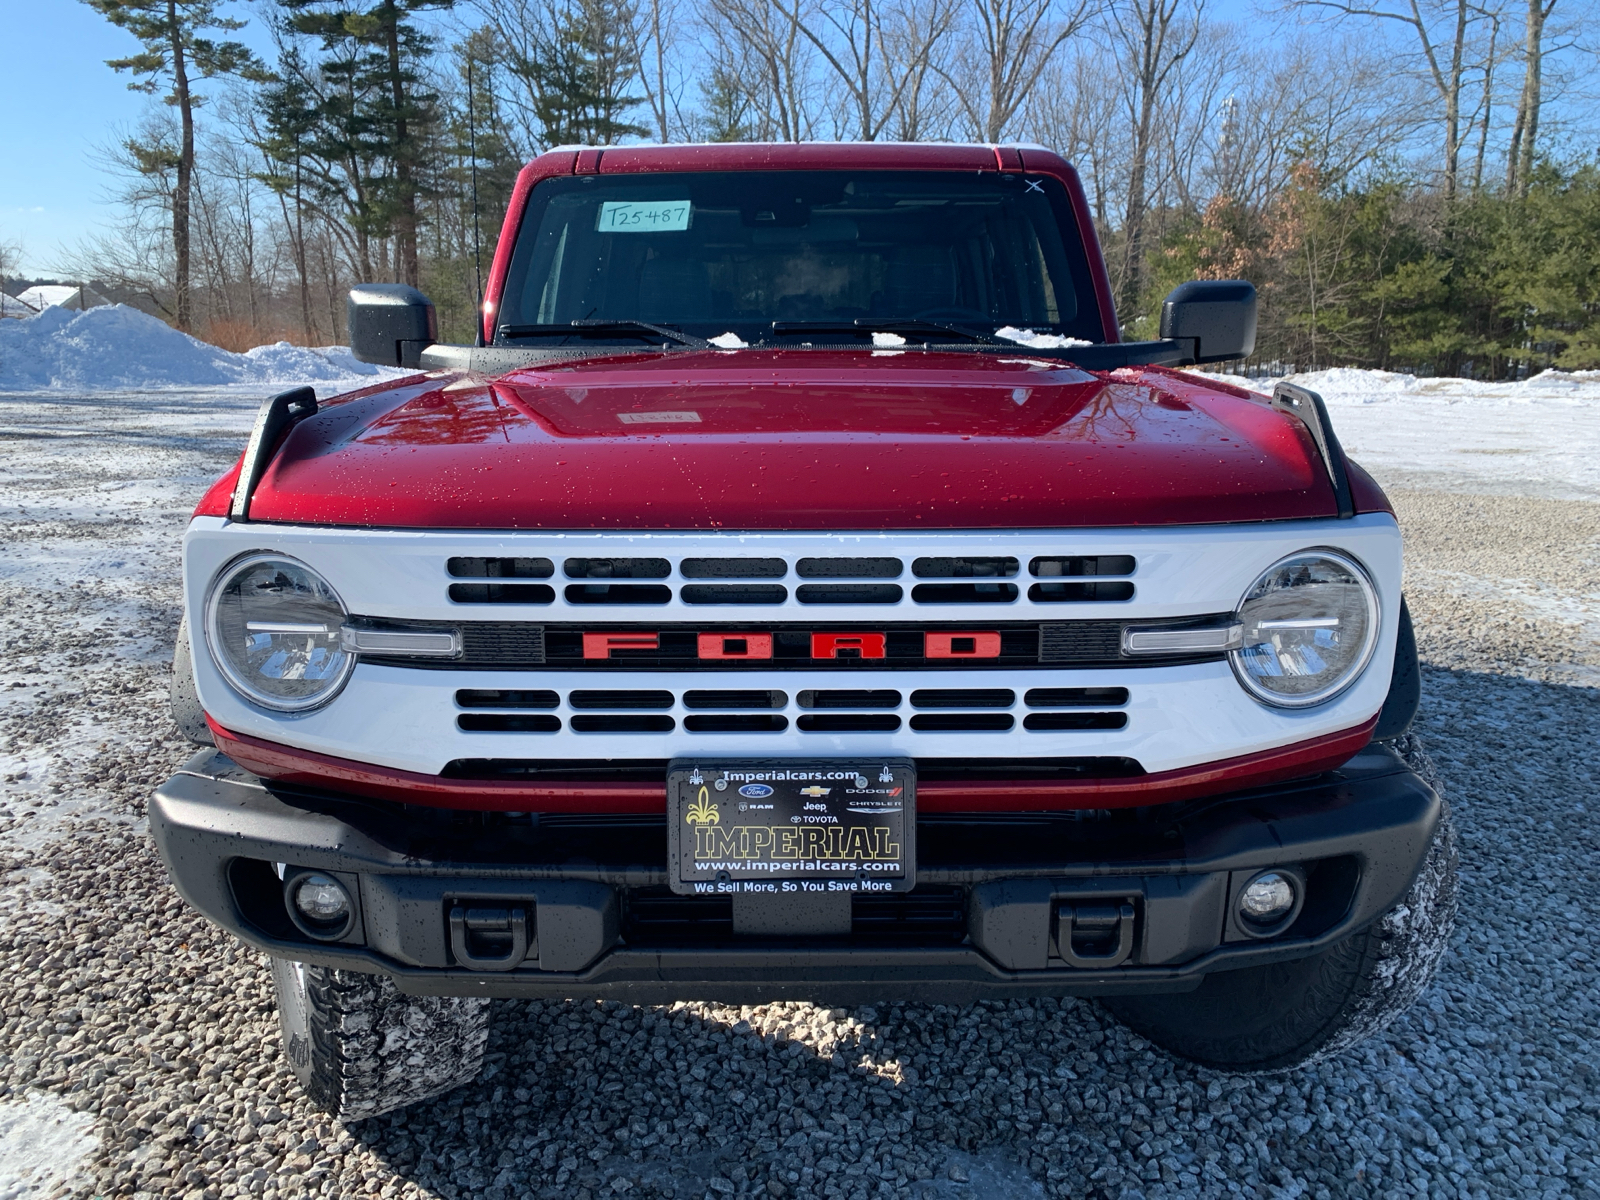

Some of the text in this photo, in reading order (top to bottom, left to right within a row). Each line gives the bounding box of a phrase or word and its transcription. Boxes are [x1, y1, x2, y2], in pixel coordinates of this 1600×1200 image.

[583, 632, 1001, 659] FORD
[723, 770, 860, 783] Imperialcars.com
[746, 786, 766, 796] Ford
[803, 802, 827, 812] Jeep
[694, 826, 900, 859] IMPERIAL
[694, 860, 900, 872] www.imperialcars.com
[694, 881, 892, 894] We Sell More, So You Save More
